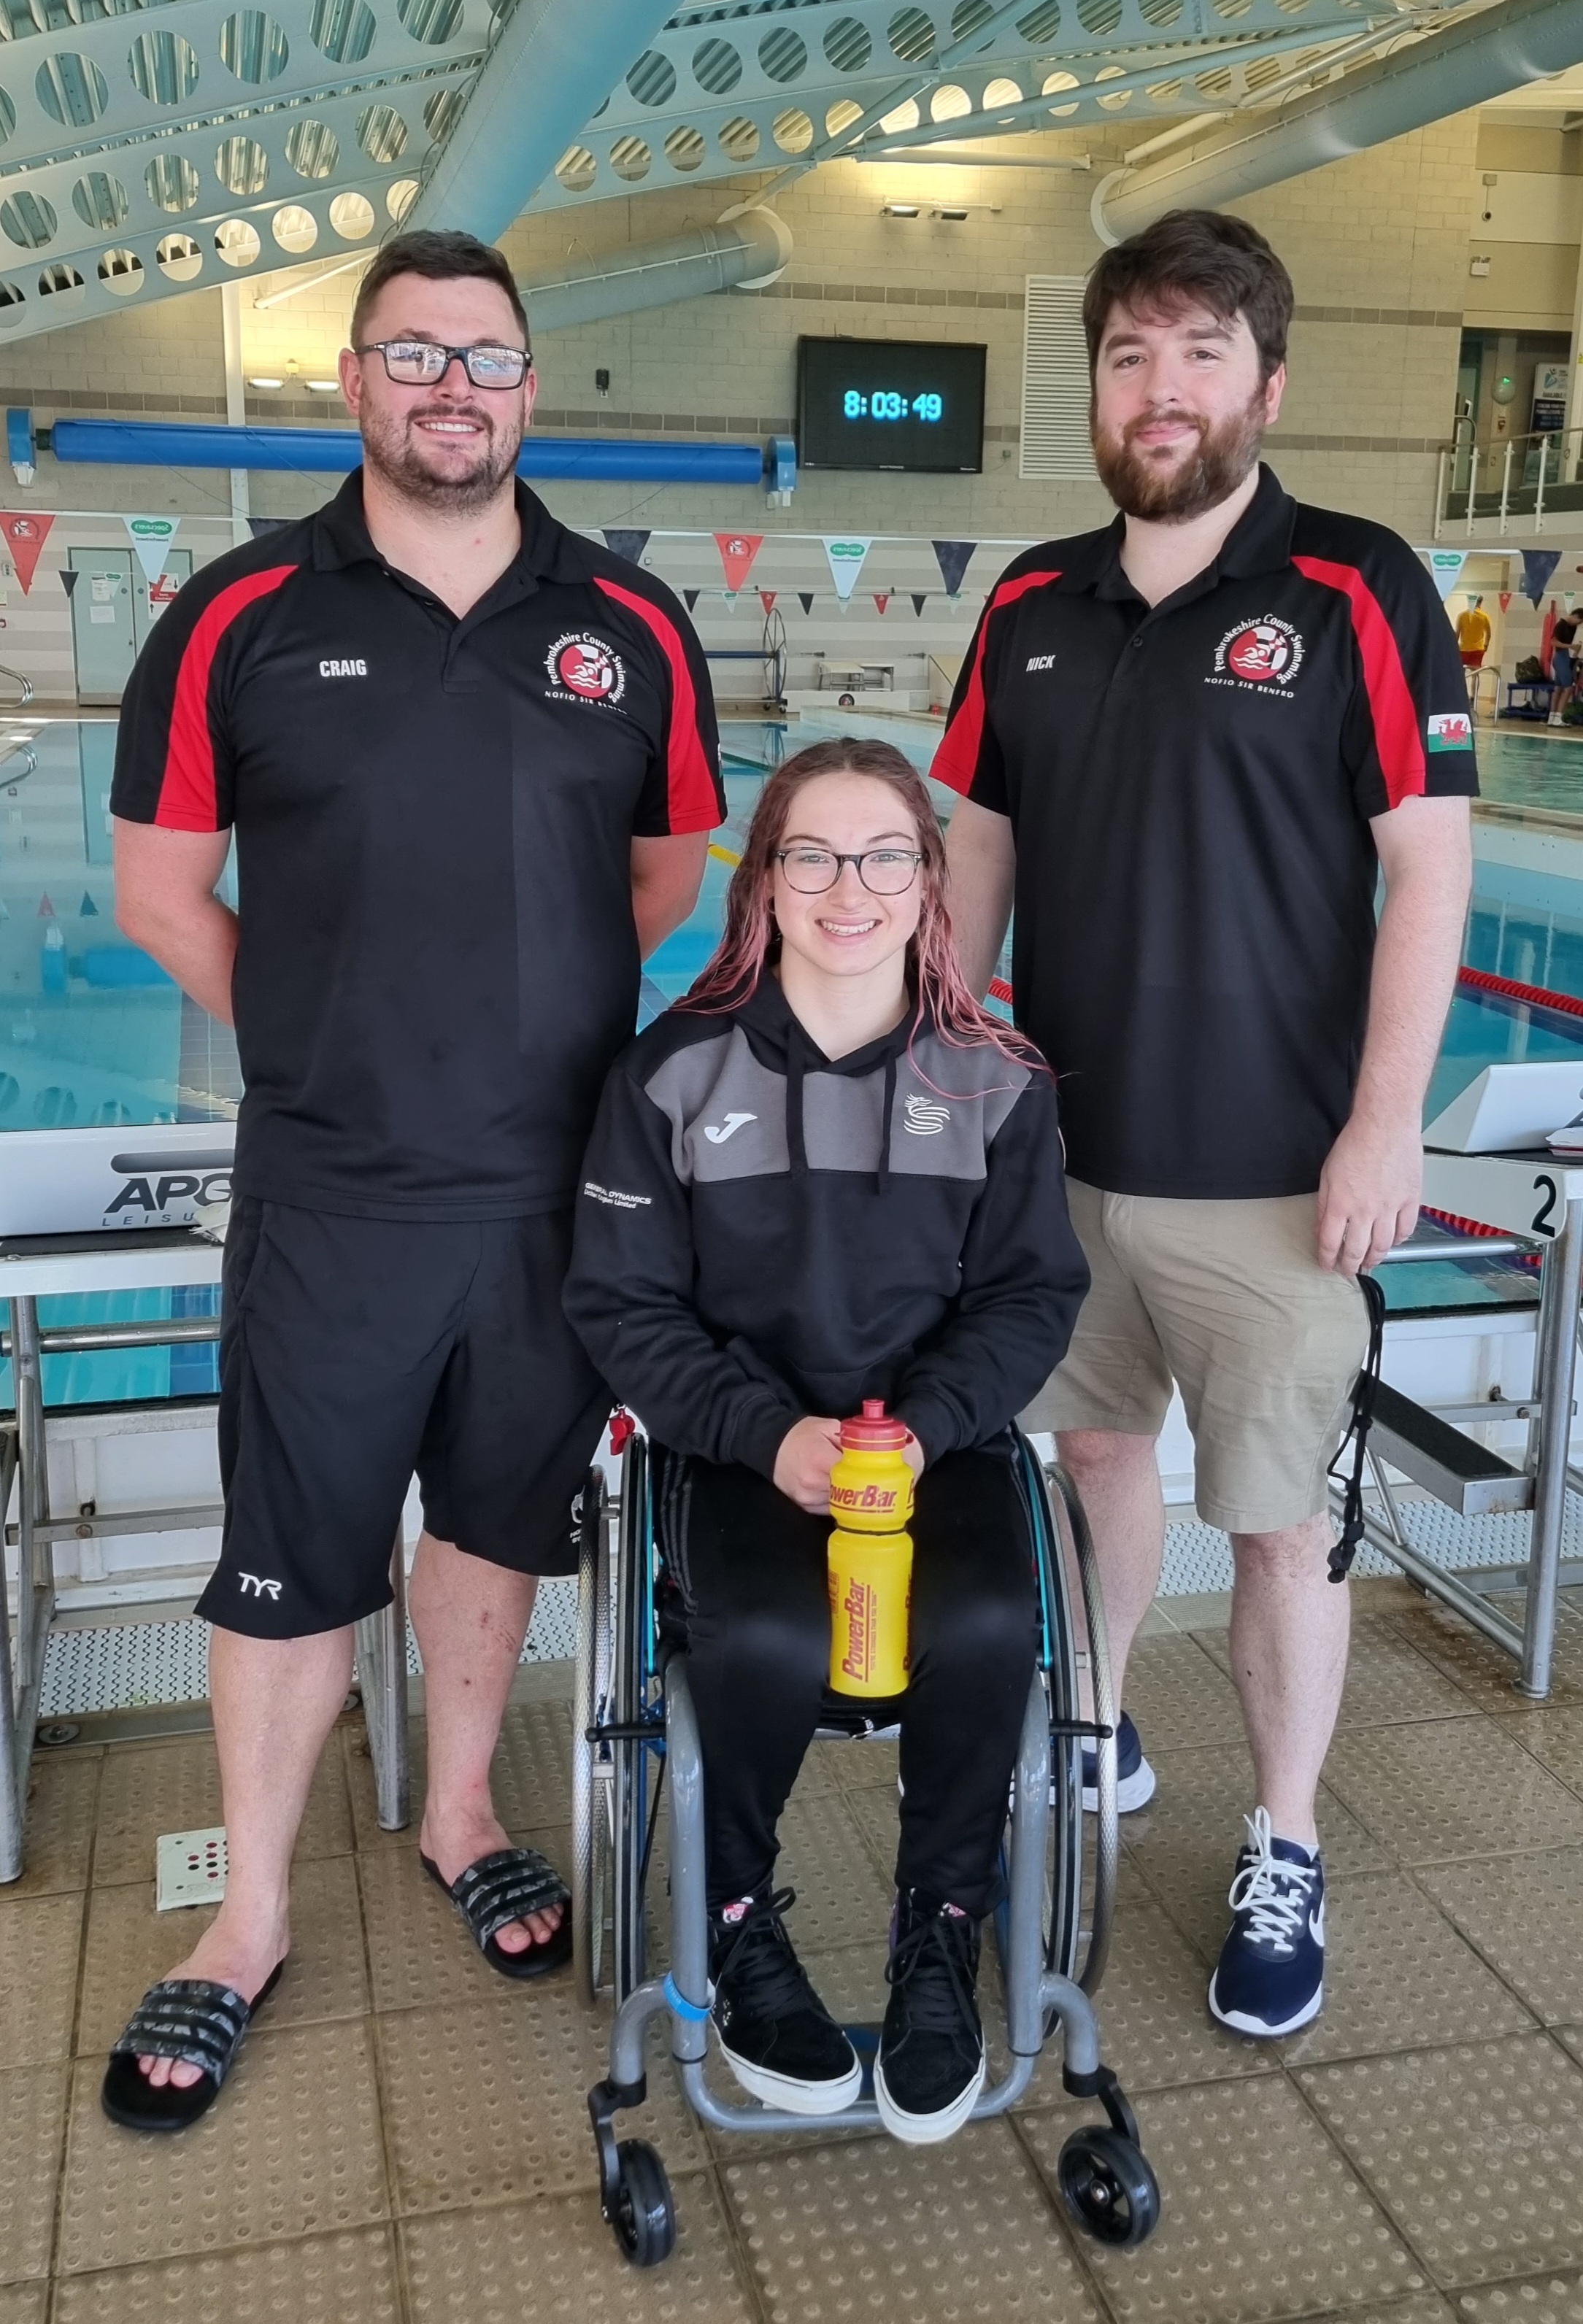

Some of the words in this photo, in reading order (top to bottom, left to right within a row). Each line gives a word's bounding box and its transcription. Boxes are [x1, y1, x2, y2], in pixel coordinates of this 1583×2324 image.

[1263, 614, 1296, 636] County
[1214, 617, 1261, 672] Pembrokeshire
[319, 659, 367, 677] CRAIG
[543, 632, 581, 686] Pembrokeshire
[582, 632, 615, 657] County
[607, 655, 626, 703] Swimming
[1025, 655, 1056, 672] NICK
[1276, 634, 1306, 684] Swimming
[544, 690, 576, 701] NOFIO
[1203, 677, 1235, 686] NOFIO
[1238, 681, 1254, 690] SIR
[1257, 685, 1294, 698] BENFRO
[609, 1191, 652, 1205] DYNAMICS
[1530, 1174, 1556, 1238] 2
[101, 1212, 194, 1227] LEISU
[830, 1484, 897, 1507] werBar
[238, 1571, 282, 1600] TYR
[842, 1576, 865, 1680] PowerBar
